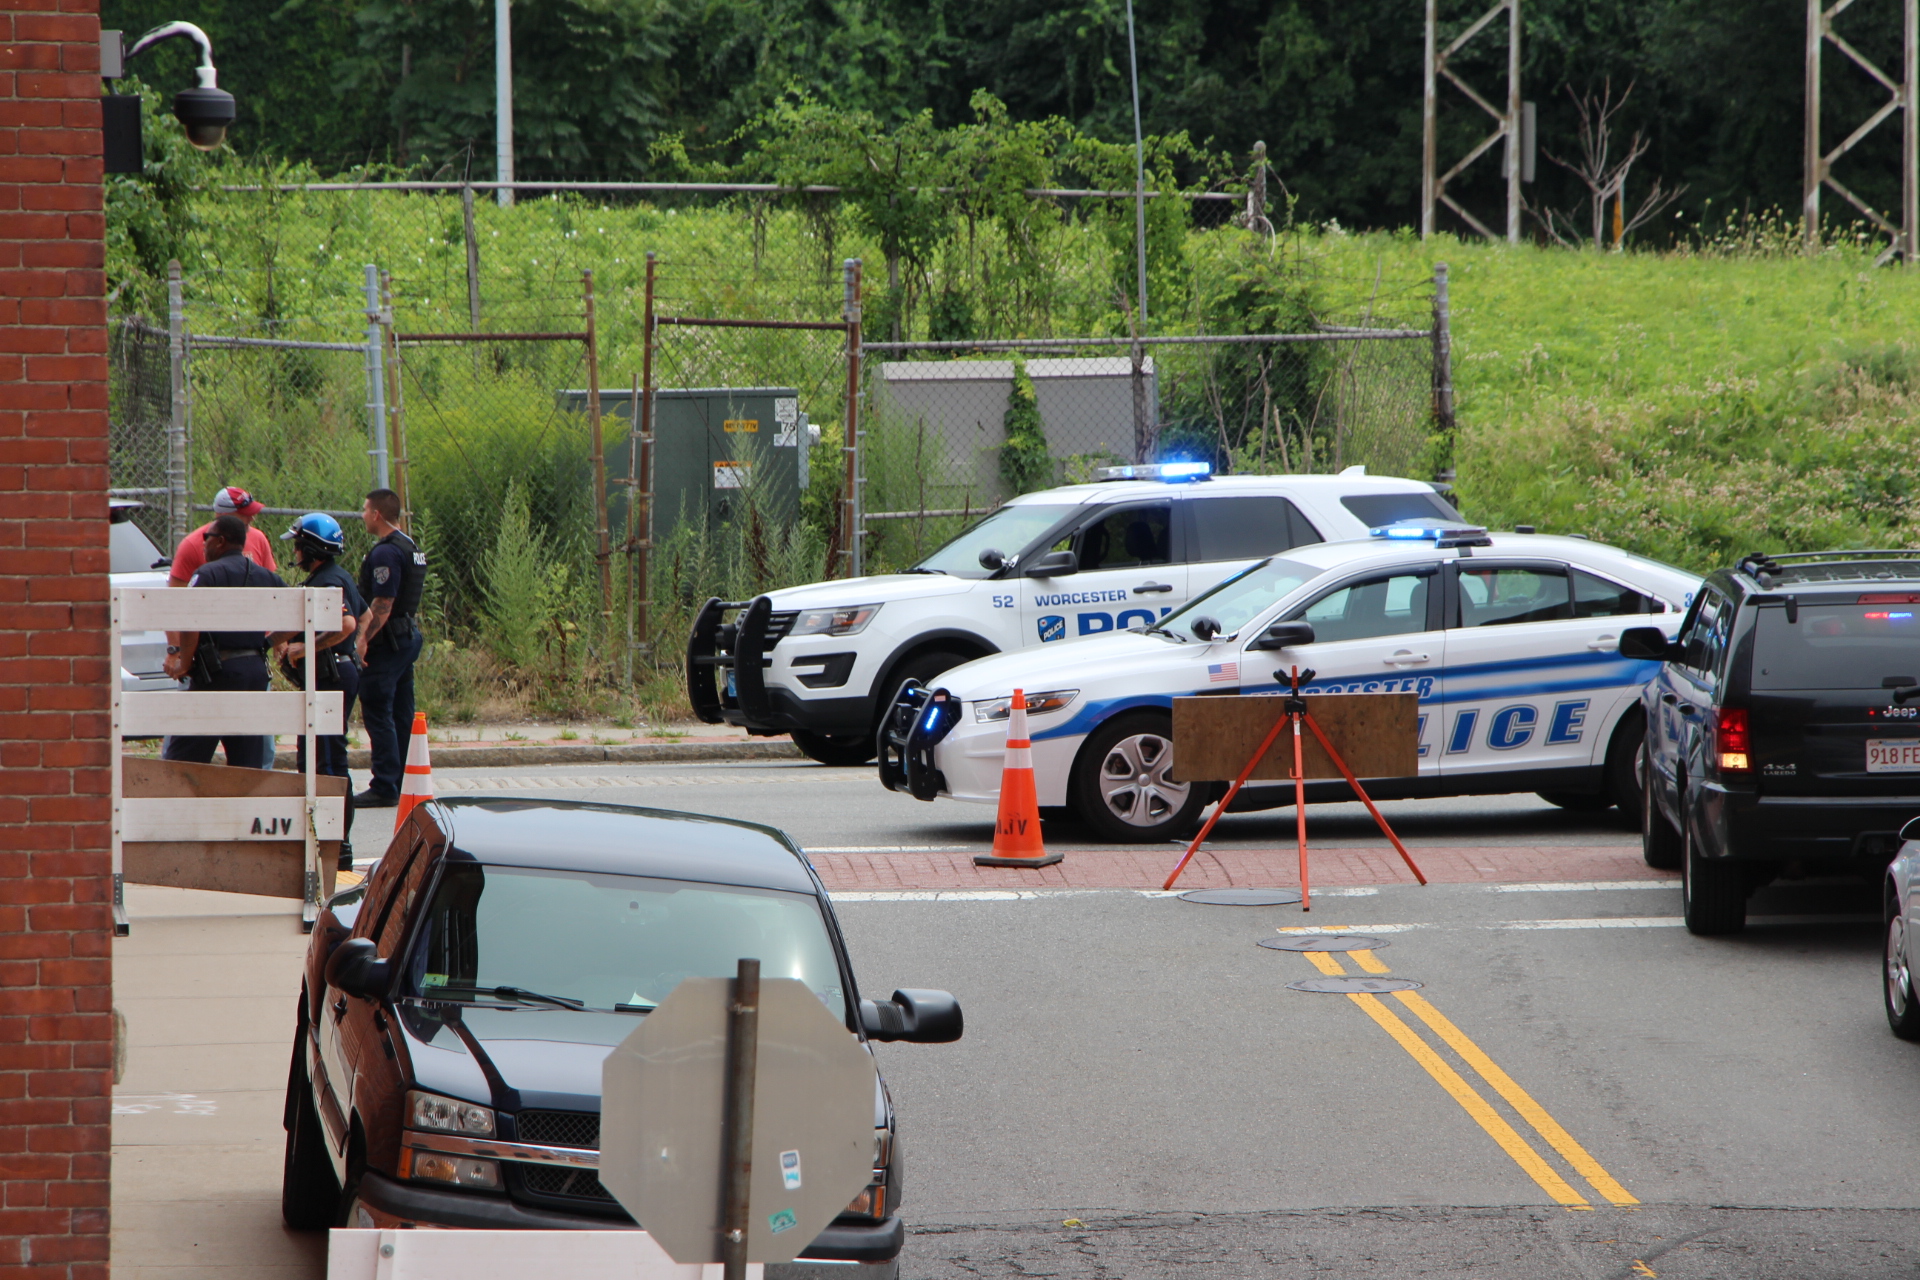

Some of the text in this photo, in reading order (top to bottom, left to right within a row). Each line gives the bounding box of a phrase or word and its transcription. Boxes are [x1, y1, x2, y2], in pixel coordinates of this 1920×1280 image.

[992, 595, 1014, 608] 52
[1034, 590, 1127, 607] WORCESTER
[1077, 607, 1172, 636] PO
[1043, 620, 1064, 641] POLICE
[1882, 705, 1918, 719] Jeep
[1870, 748, 1899, 765] 918
[250, 817, 292, 836] AJV
